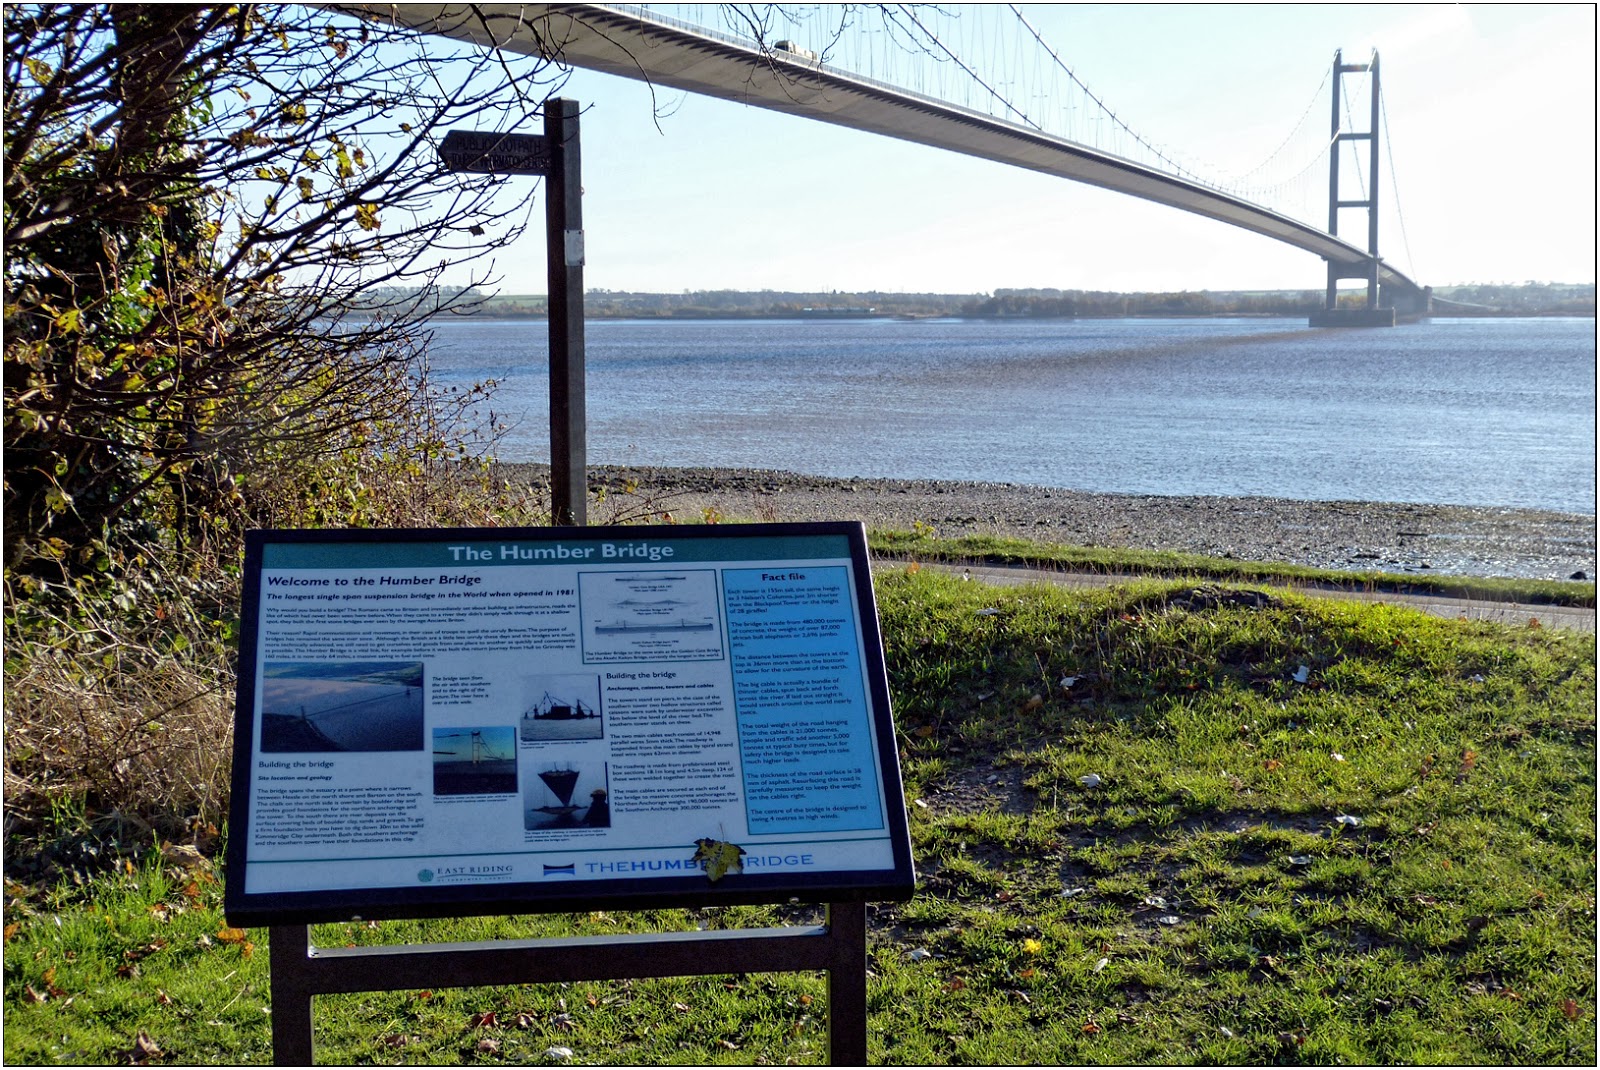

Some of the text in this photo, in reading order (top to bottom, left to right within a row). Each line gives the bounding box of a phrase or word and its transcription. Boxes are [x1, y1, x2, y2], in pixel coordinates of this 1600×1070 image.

[448, 543, 674, 561] The Humber Bridge
[268, 574, 481, 587] Welcome to the Humber Bridge
[761, 573, 786, 581] Fact
[364, 593, 408, 601] suspension
[410, 592, 436, 600] bridge
[513, 590, 544, 598] opened
[606, 672, 636, 681] Building
[652, 671, 677, 680] bridge
[258, 761, 291, 770] Building
[308, 760, 334, 769] bridge
[470, 865, 513, 873] RIDING
